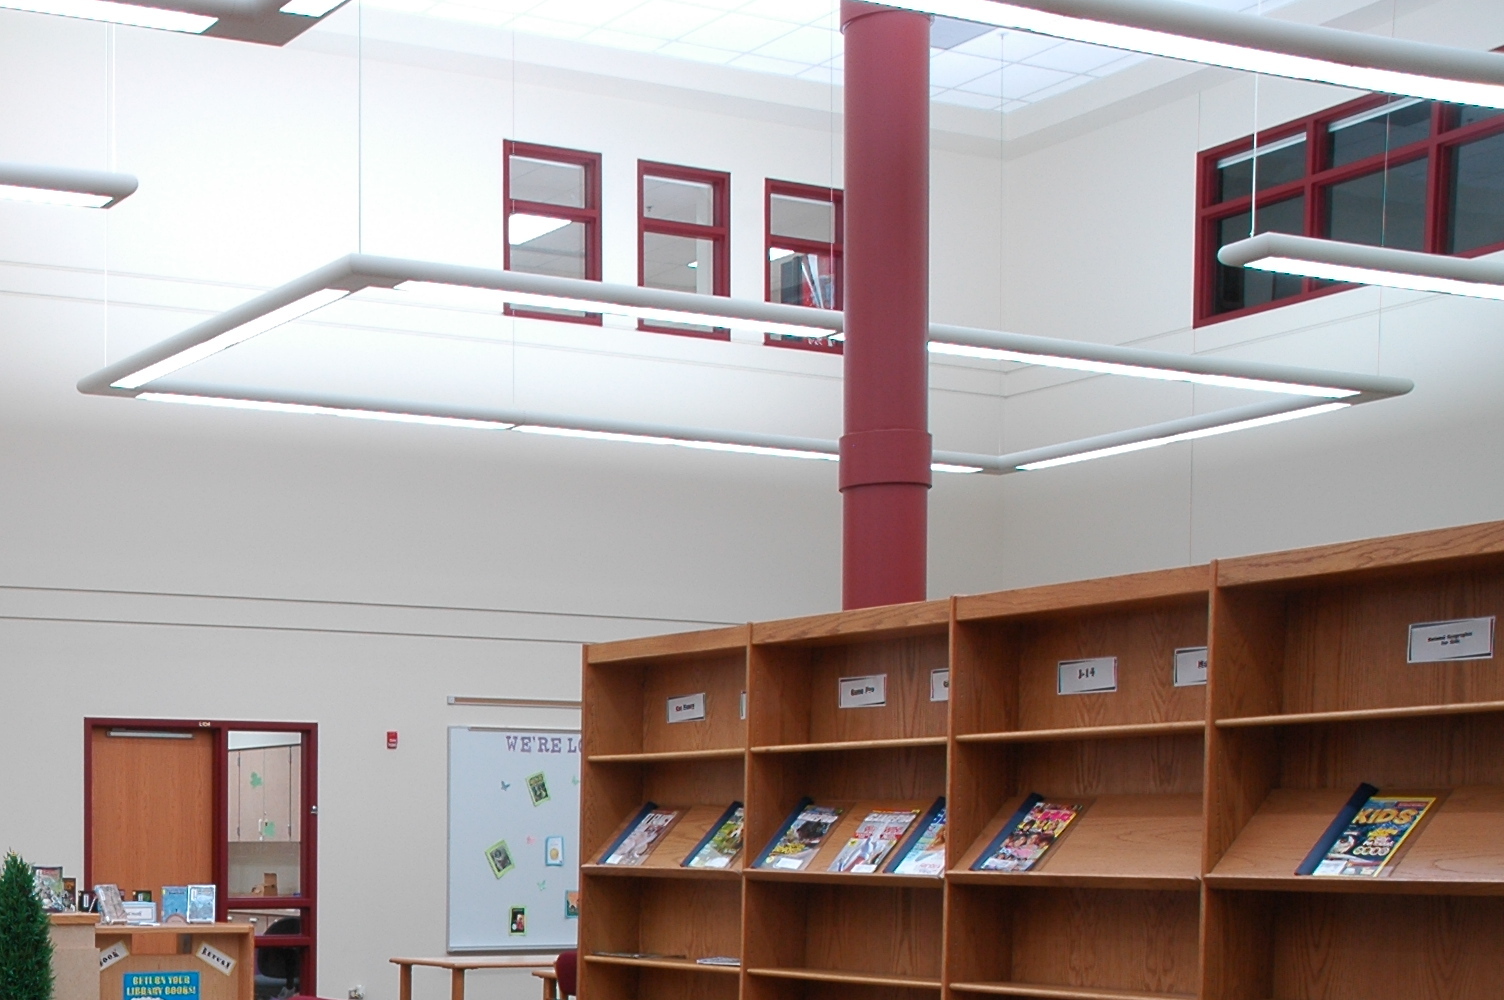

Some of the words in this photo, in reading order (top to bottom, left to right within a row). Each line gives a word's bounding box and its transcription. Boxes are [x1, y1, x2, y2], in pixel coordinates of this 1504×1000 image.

[506, 736, 562, 753] WE'RE
[1352, 808, 1418, 825] KIDS
[167, 976, 190, 985] YOUR
[126, 987, 163, 996] LIBRARY
